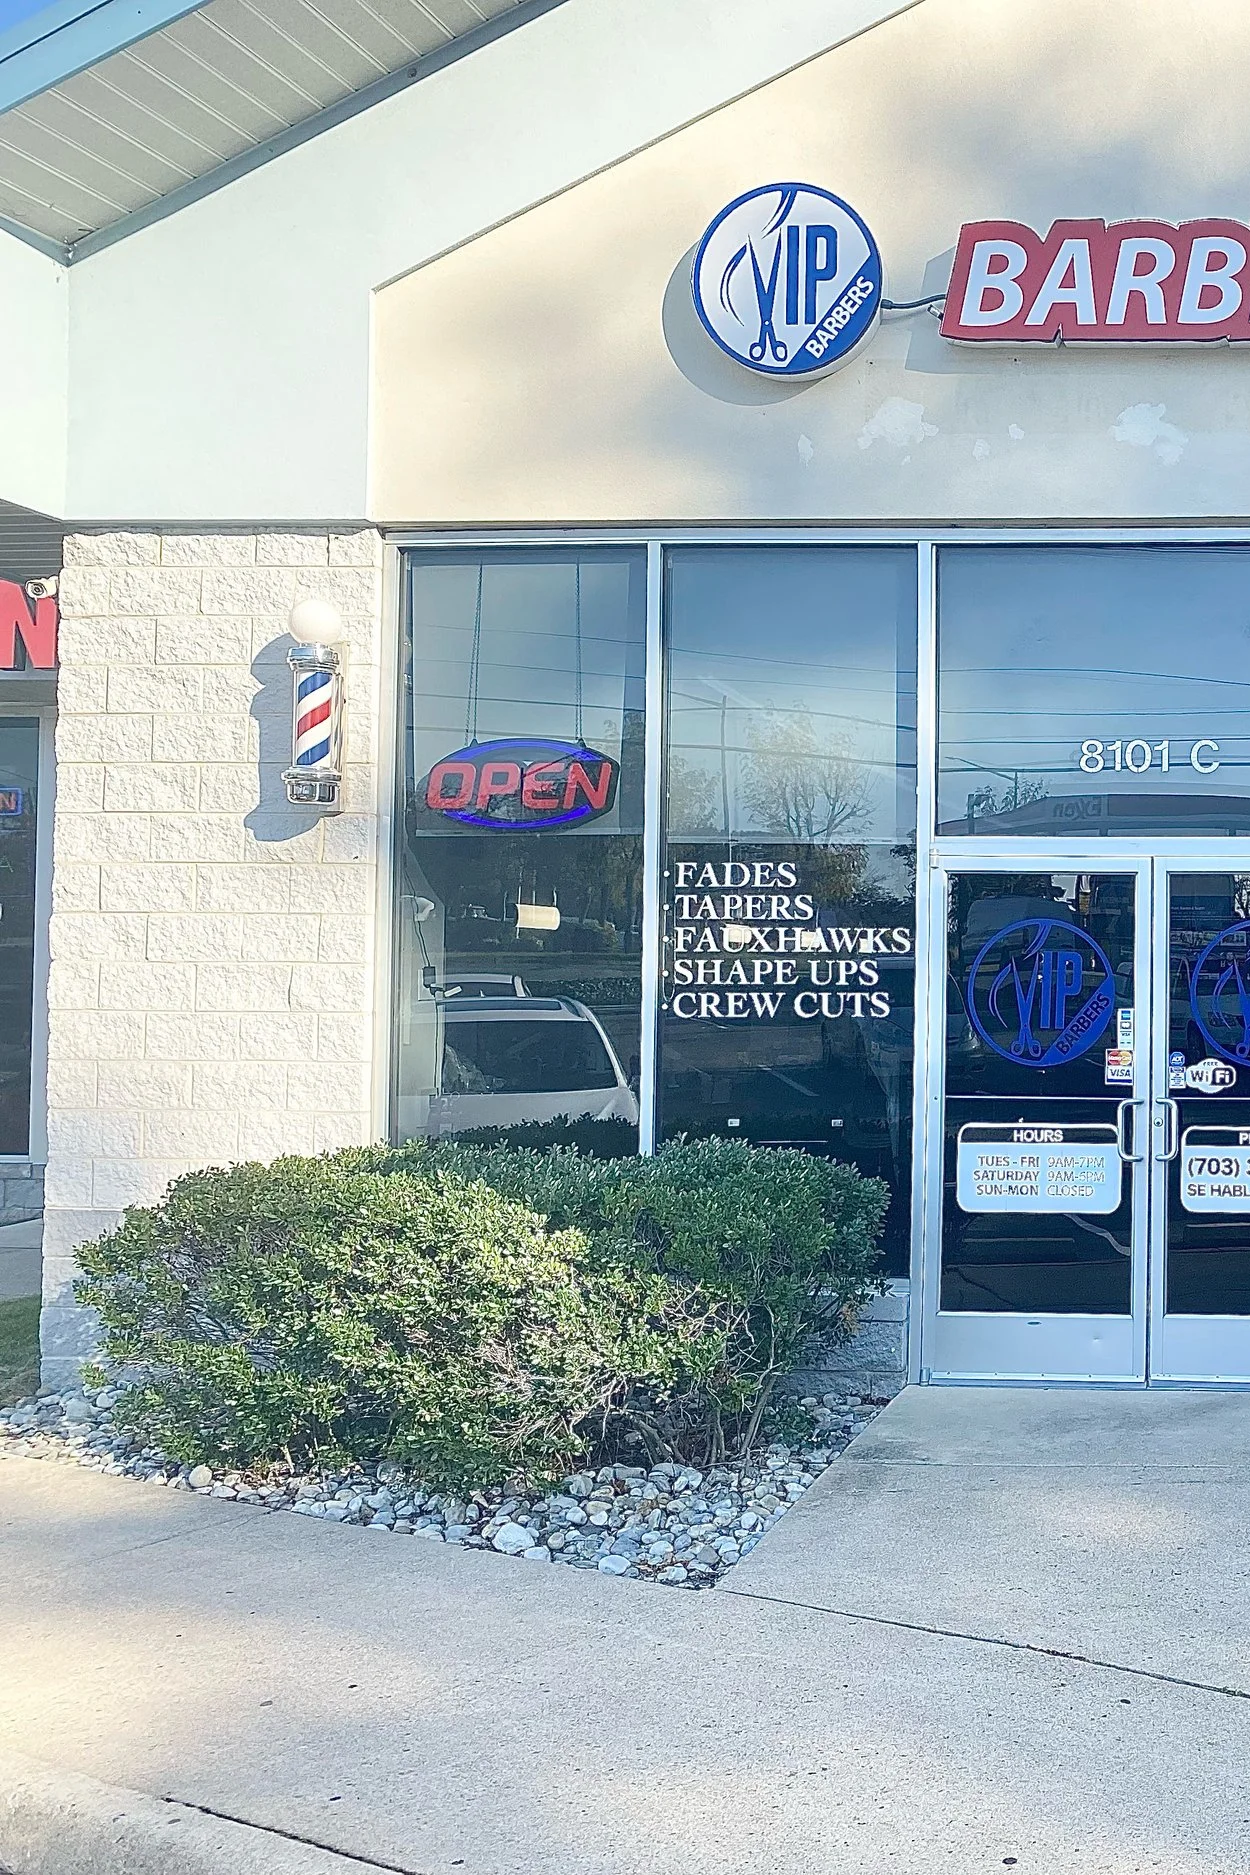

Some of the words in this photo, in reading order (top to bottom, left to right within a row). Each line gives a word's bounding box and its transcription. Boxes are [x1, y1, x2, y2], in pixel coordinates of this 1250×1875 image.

[804, 275, 875, 359] BARBERS
[1079, 739, 1169, 773] 8101
[1190, 739, 1220, 774] C
[427, 761, 612, 809] OPEN
[674, 862, 797, 888] FADES
[674, 894, 814, 921] TAPERS
[673, 926, 911, 954] FAUXHAWKS
[673, 959, 800, 985] SHAPE
[807, 959, 879, 986] UPS
[673, 992, 786, 1018] CREW
[793, 992, 891, 1019] CUTS
[1055, 993, 1111, 1056] BARBERS
[1110, 1068, 1131, 1078] VISA
[1013, 1130, 1064, 1142] HOURS
[978, 1156, 1010, 1167] TUES
[1021, 1156, 1040, 1168] FRI
[1187, 1157, 1240, 1178] (703)
[973, 1170, 1040, 1181] SATURDAY
[976, 1184, 1039, 1196] SUN-MON
[1047, 1184, 1094, 1197] CLOSED
[1187, 1183, 1206, 1197] SE
